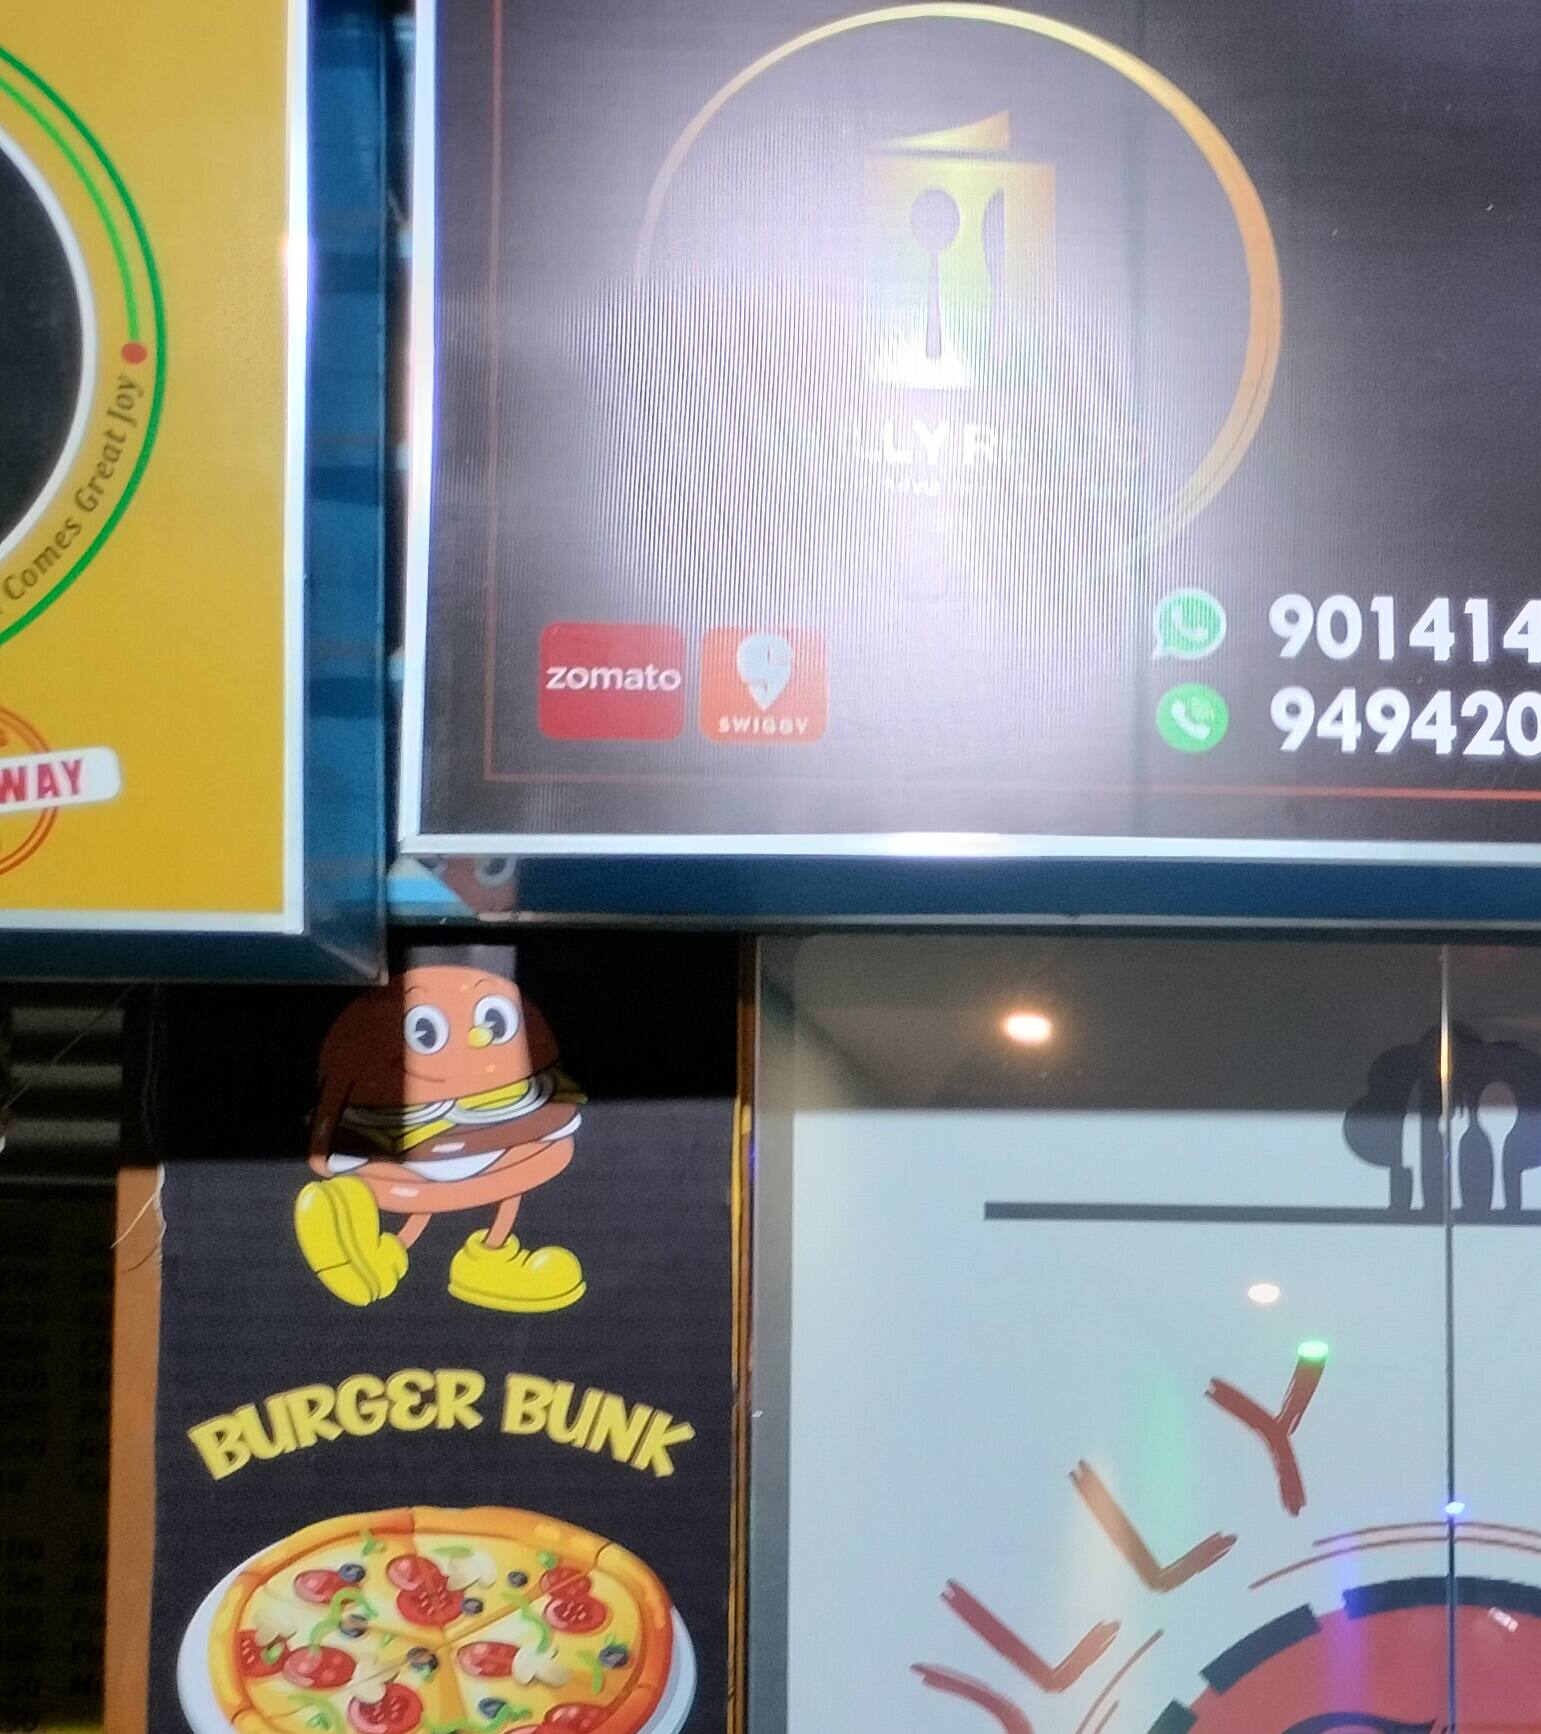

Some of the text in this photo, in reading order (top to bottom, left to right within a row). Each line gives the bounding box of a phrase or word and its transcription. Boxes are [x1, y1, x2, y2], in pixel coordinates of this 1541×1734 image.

[3, 374, 144, 601] Comes Great Joy
[545, 663, 682, 692] zomato
[187, 1367, 697, 1482] BURGER BUNK
